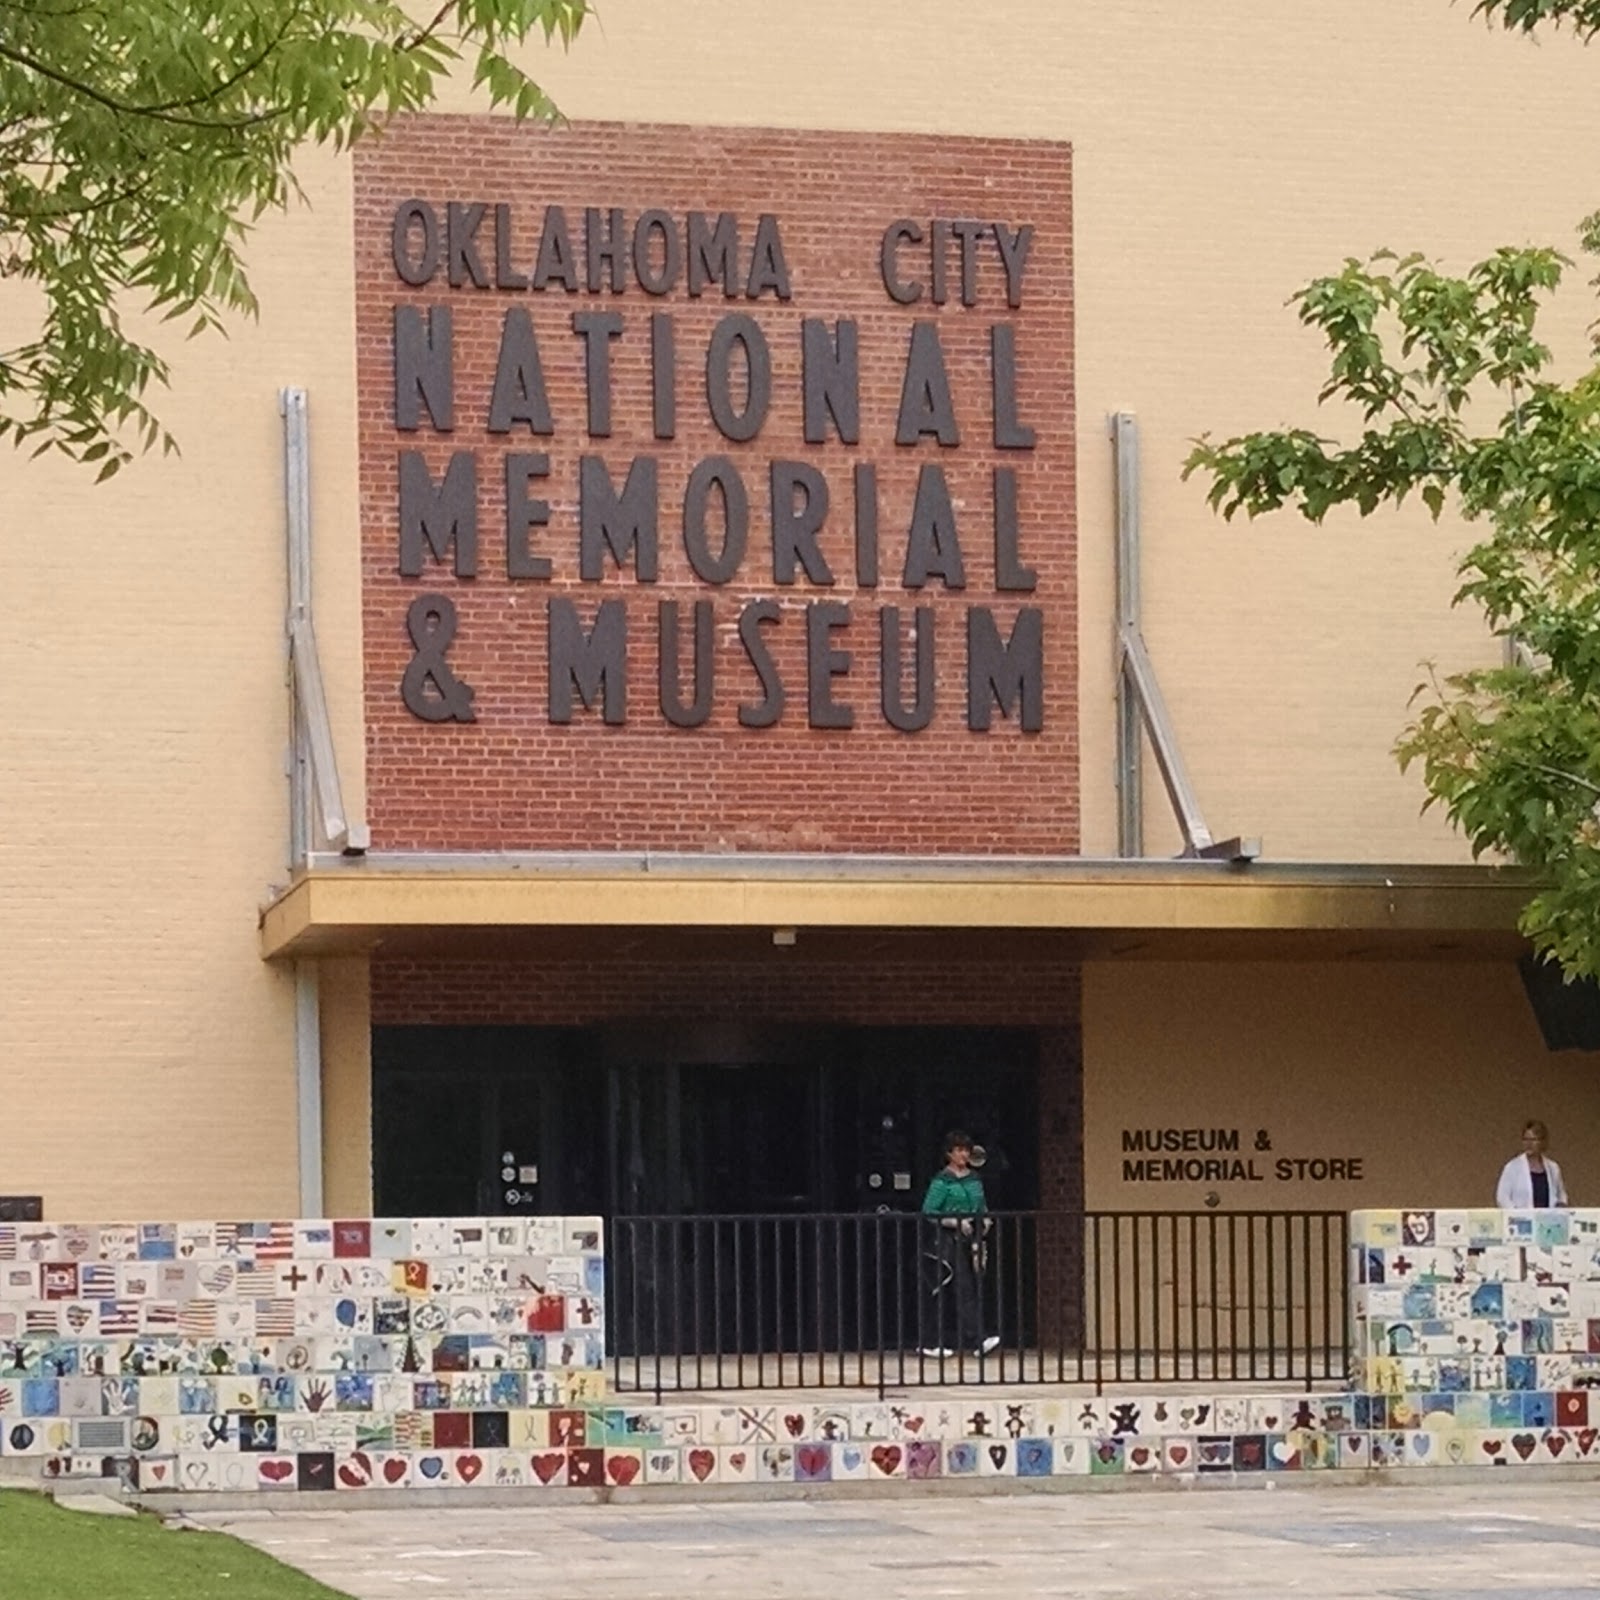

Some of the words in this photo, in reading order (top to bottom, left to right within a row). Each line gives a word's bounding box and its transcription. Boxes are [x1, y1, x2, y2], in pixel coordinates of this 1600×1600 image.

[392, 199, 791, 301] OKLAHOMA
[880, 218, 1034, 308] CITY
[393, 305, 1036, 449] NATIONAL
[399, 450, 1037, 591] MEMORIAL
[402, 594, 477, 722] &
[548, 598, 1043, 733] MUSEUM
[1122, 1129, 1239, 1152] MUSEUM
[1254, 1130, 1272, 1152] &
[1123, 1158, 1263, 1181] MEMORIAL
[1275, 1157, 1363, 1180] STORE
